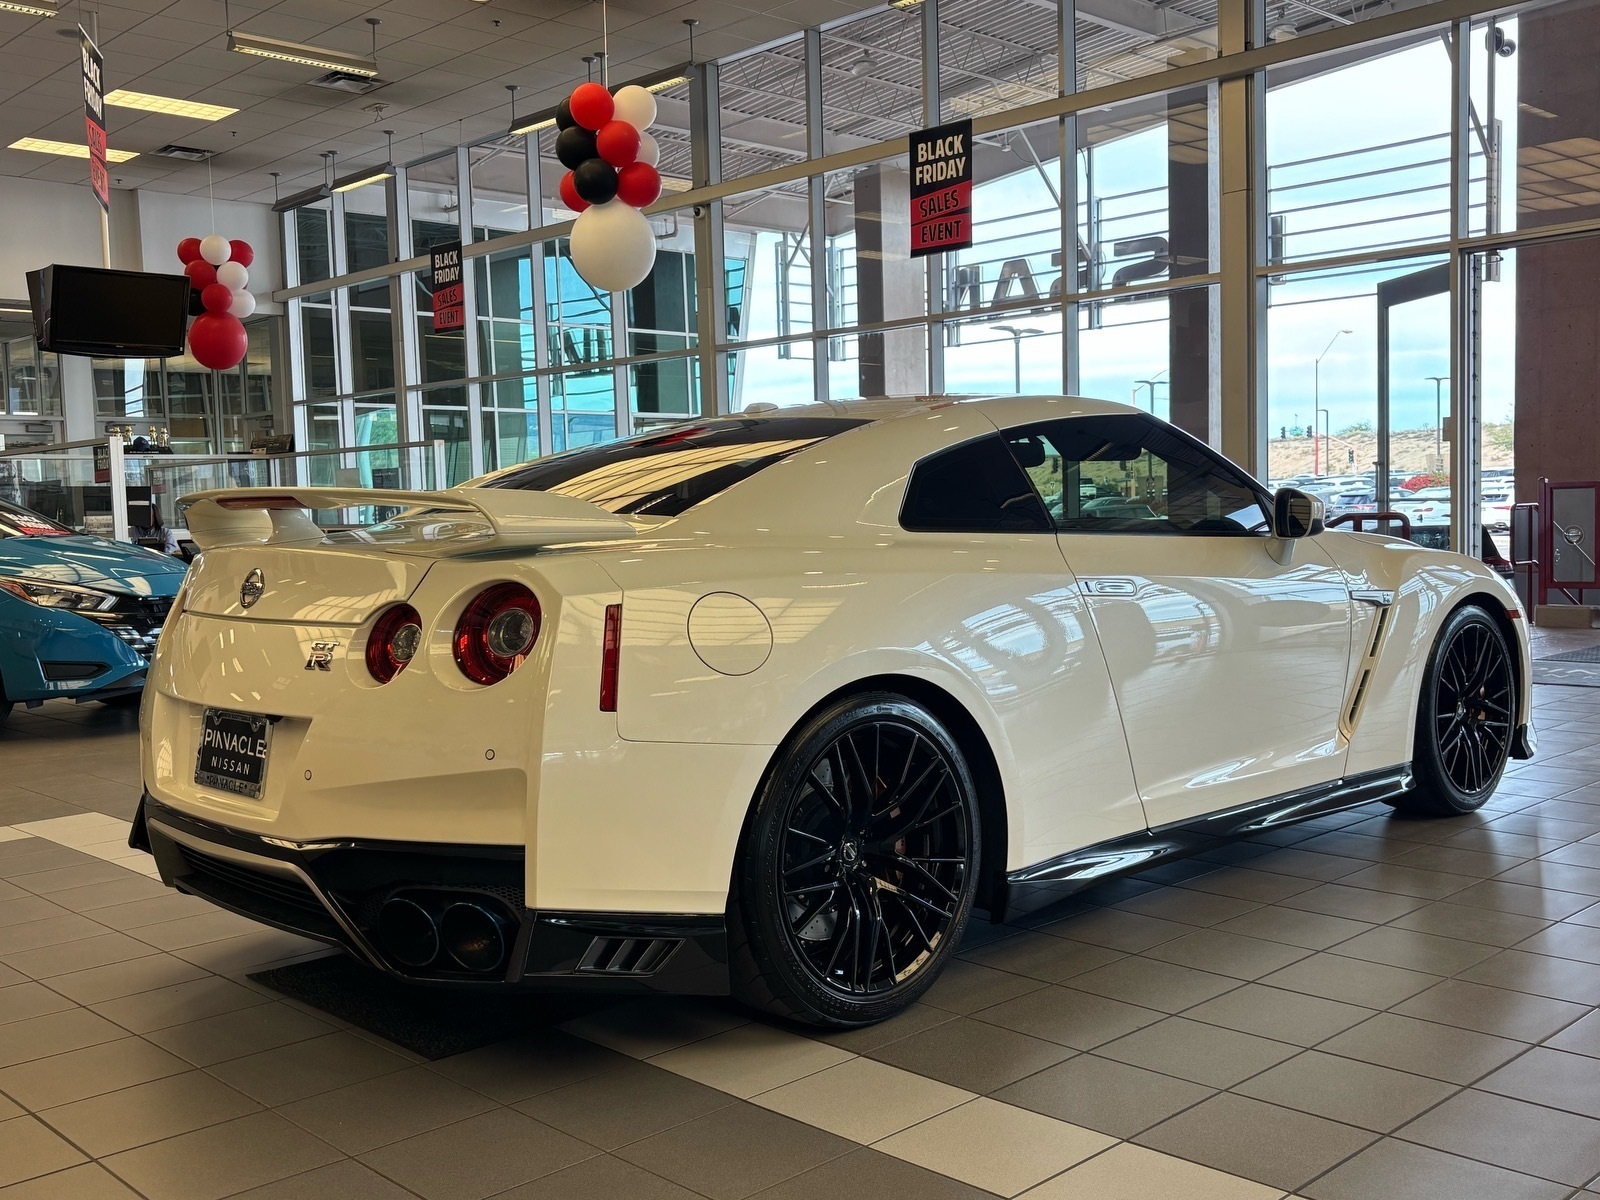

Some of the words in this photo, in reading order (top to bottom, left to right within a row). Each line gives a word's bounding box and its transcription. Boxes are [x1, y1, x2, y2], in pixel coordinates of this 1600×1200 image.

[917, 134, 964, 163] BLACK
[915, 156, 967, 186] FRIDAY
[920, 189, 959, 218] SALES
[921, 220, 962, 243] EVENT
[434, 251, 458, 268] BLACK
[434, 266, 460, 284] FRIDAY
[437, 289, 458, 307] SALES
[439, 310, 459, 325] EVENT
[211, 755, 250, 776] NISSAN
